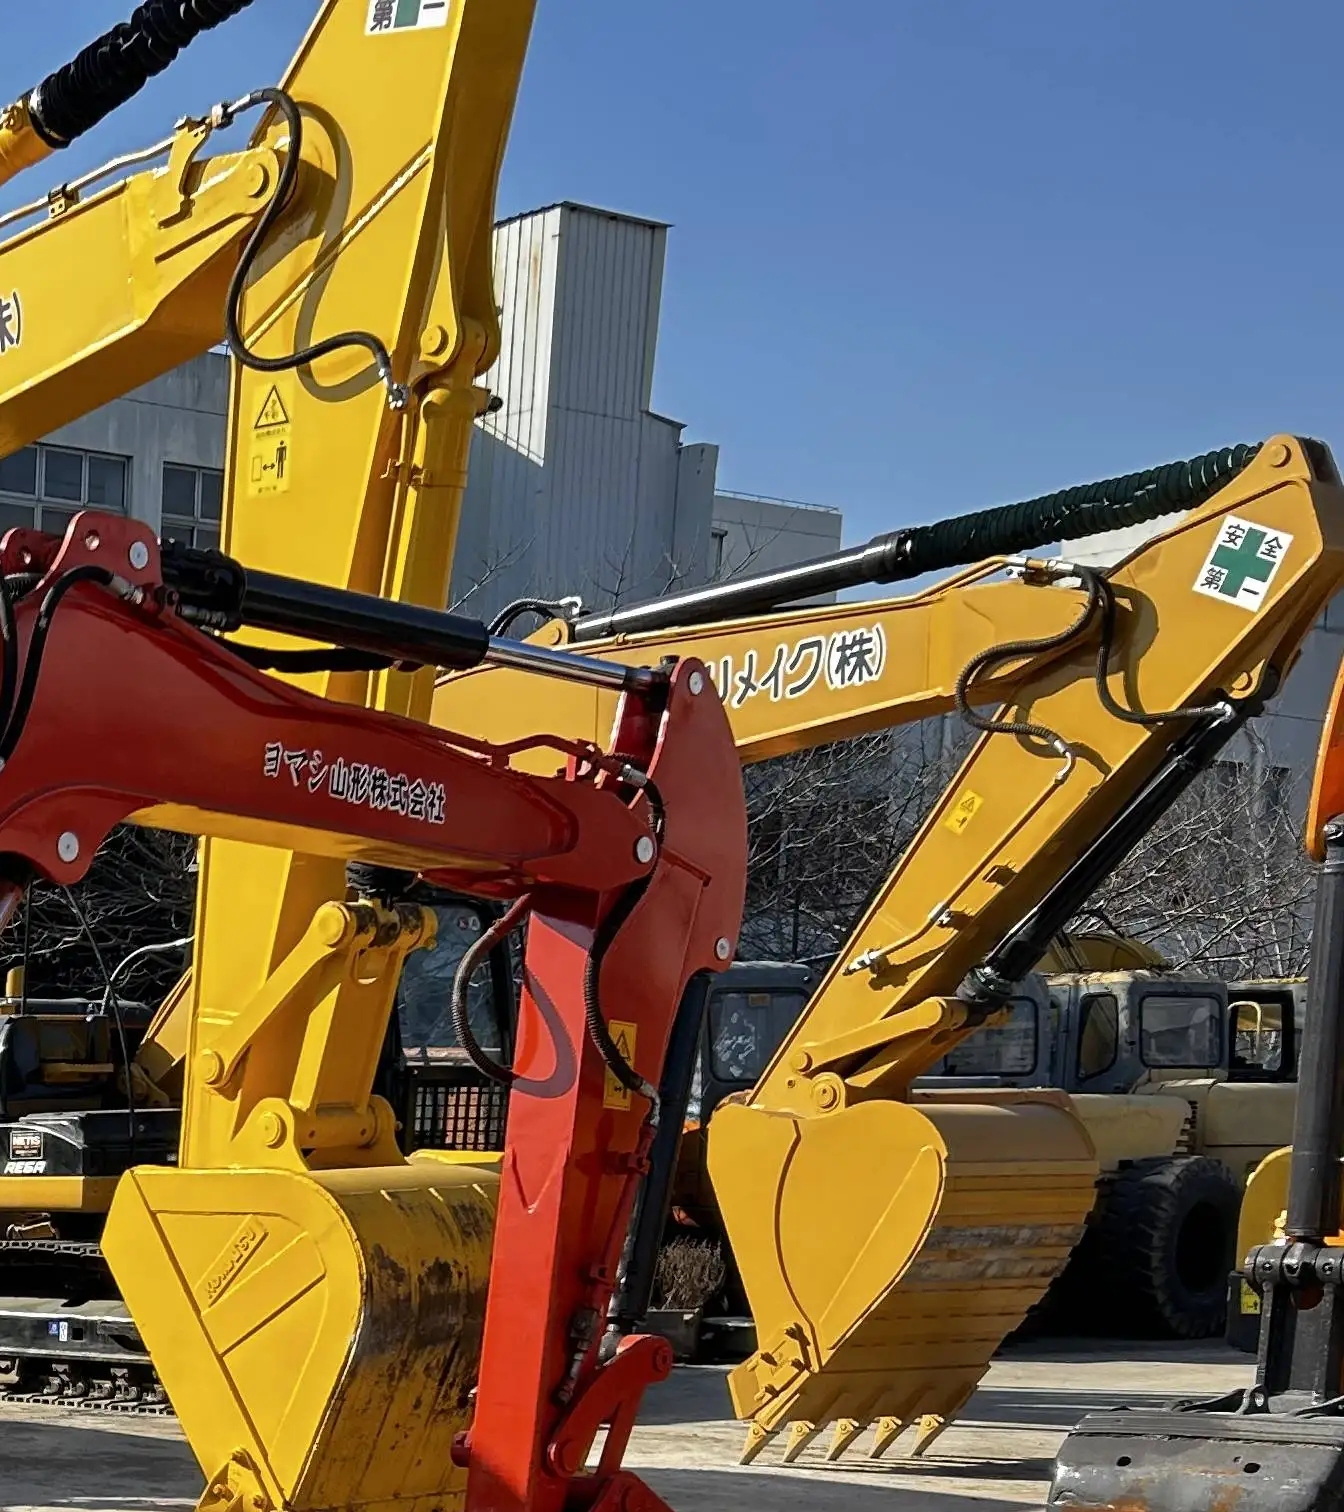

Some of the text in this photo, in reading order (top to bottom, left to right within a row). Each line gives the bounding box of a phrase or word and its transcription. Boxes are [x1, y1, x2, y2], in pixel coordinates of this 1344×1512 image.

[263, 741, 447, 825] ヨマシ山形株式会社
